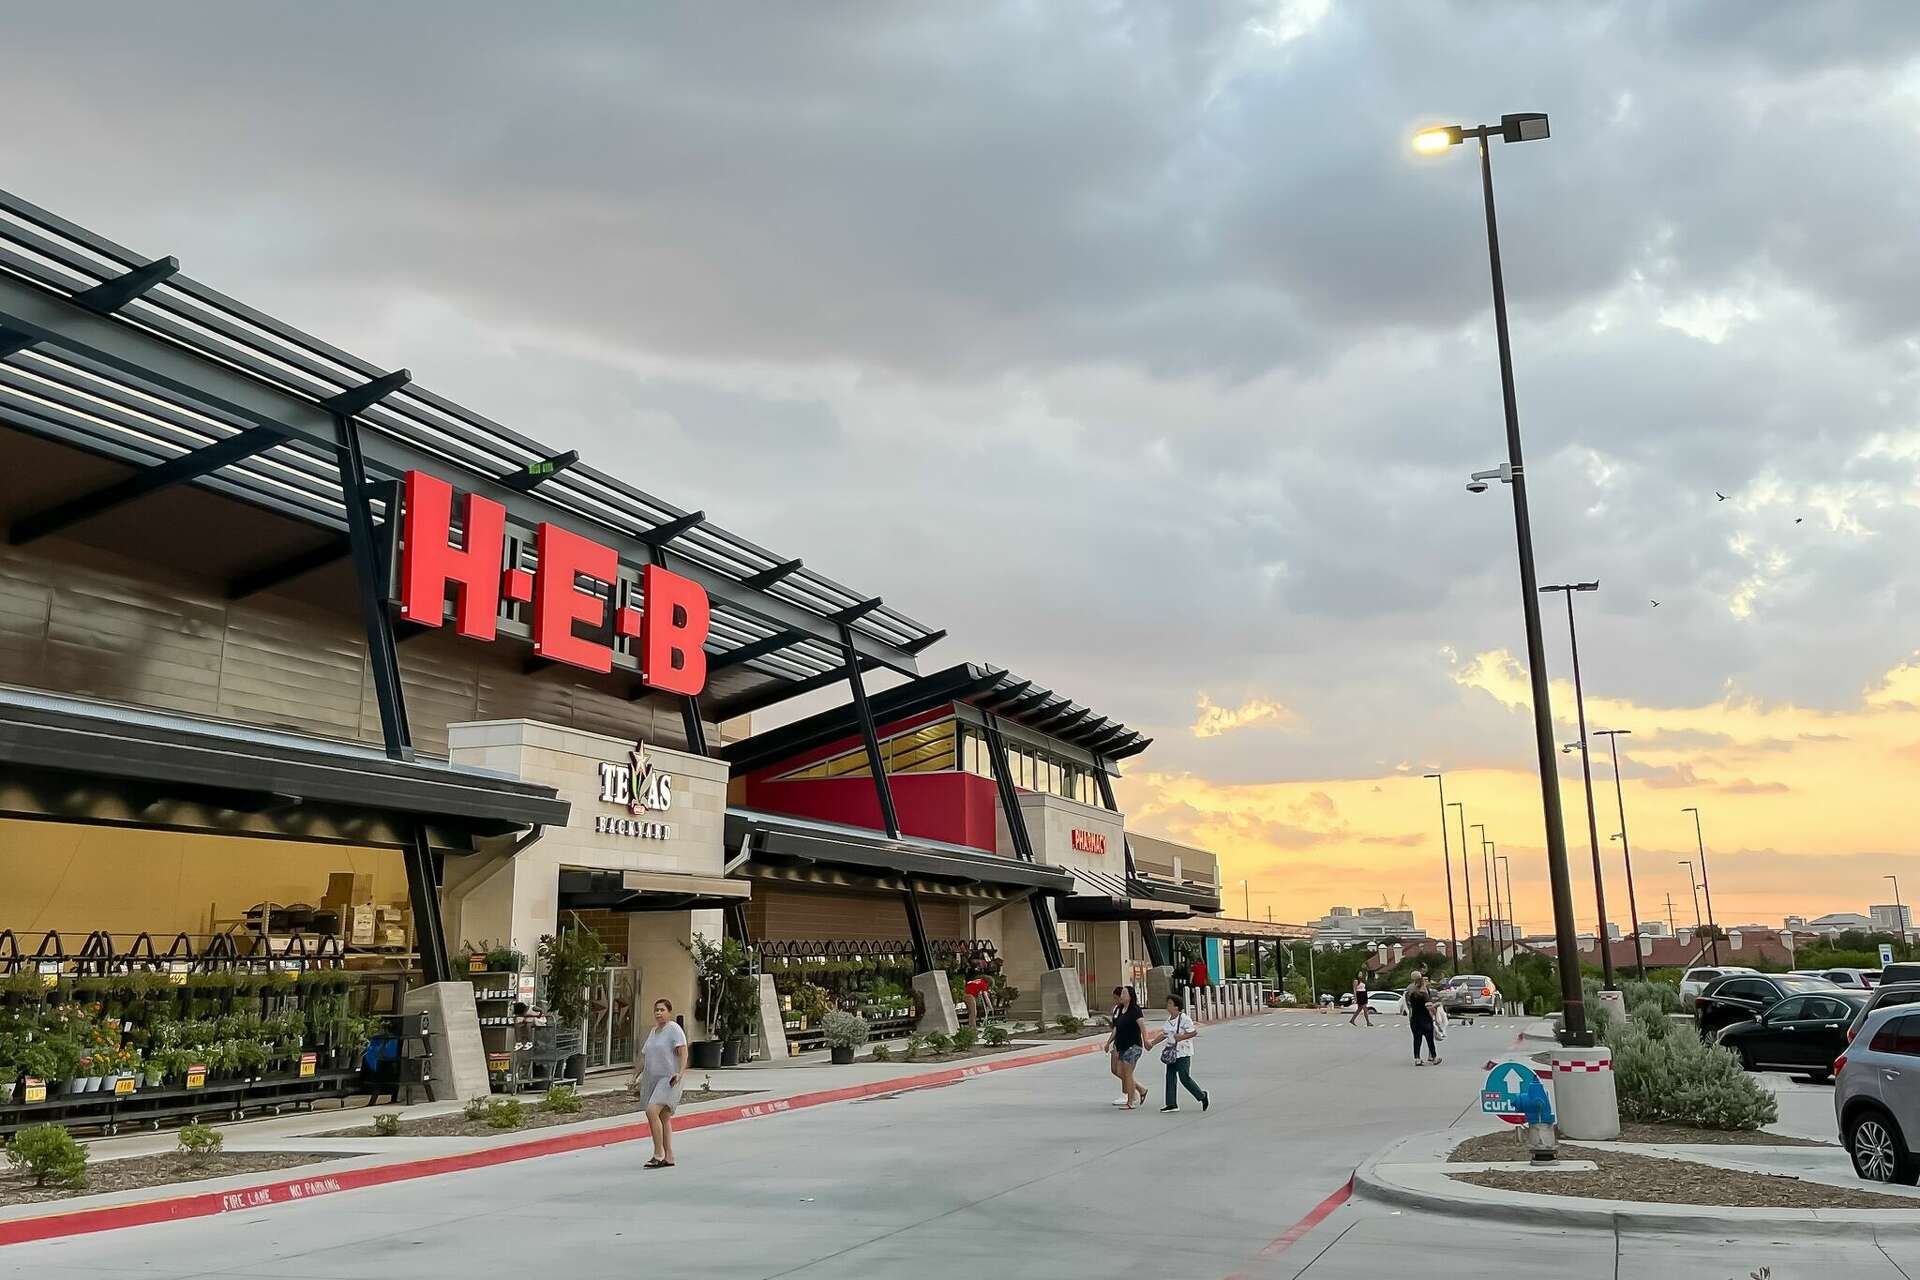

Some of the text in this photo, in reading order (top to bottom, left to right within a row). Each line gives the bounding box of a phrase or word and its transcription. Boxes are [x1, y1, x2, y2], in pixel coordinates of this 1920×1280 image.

[596, 816, 672, 840] BACKYARD
[1072, 829, 1106, 855] PHARMACY
[222, 1178, 341, 1211] FIRE LANE NO PARKING
